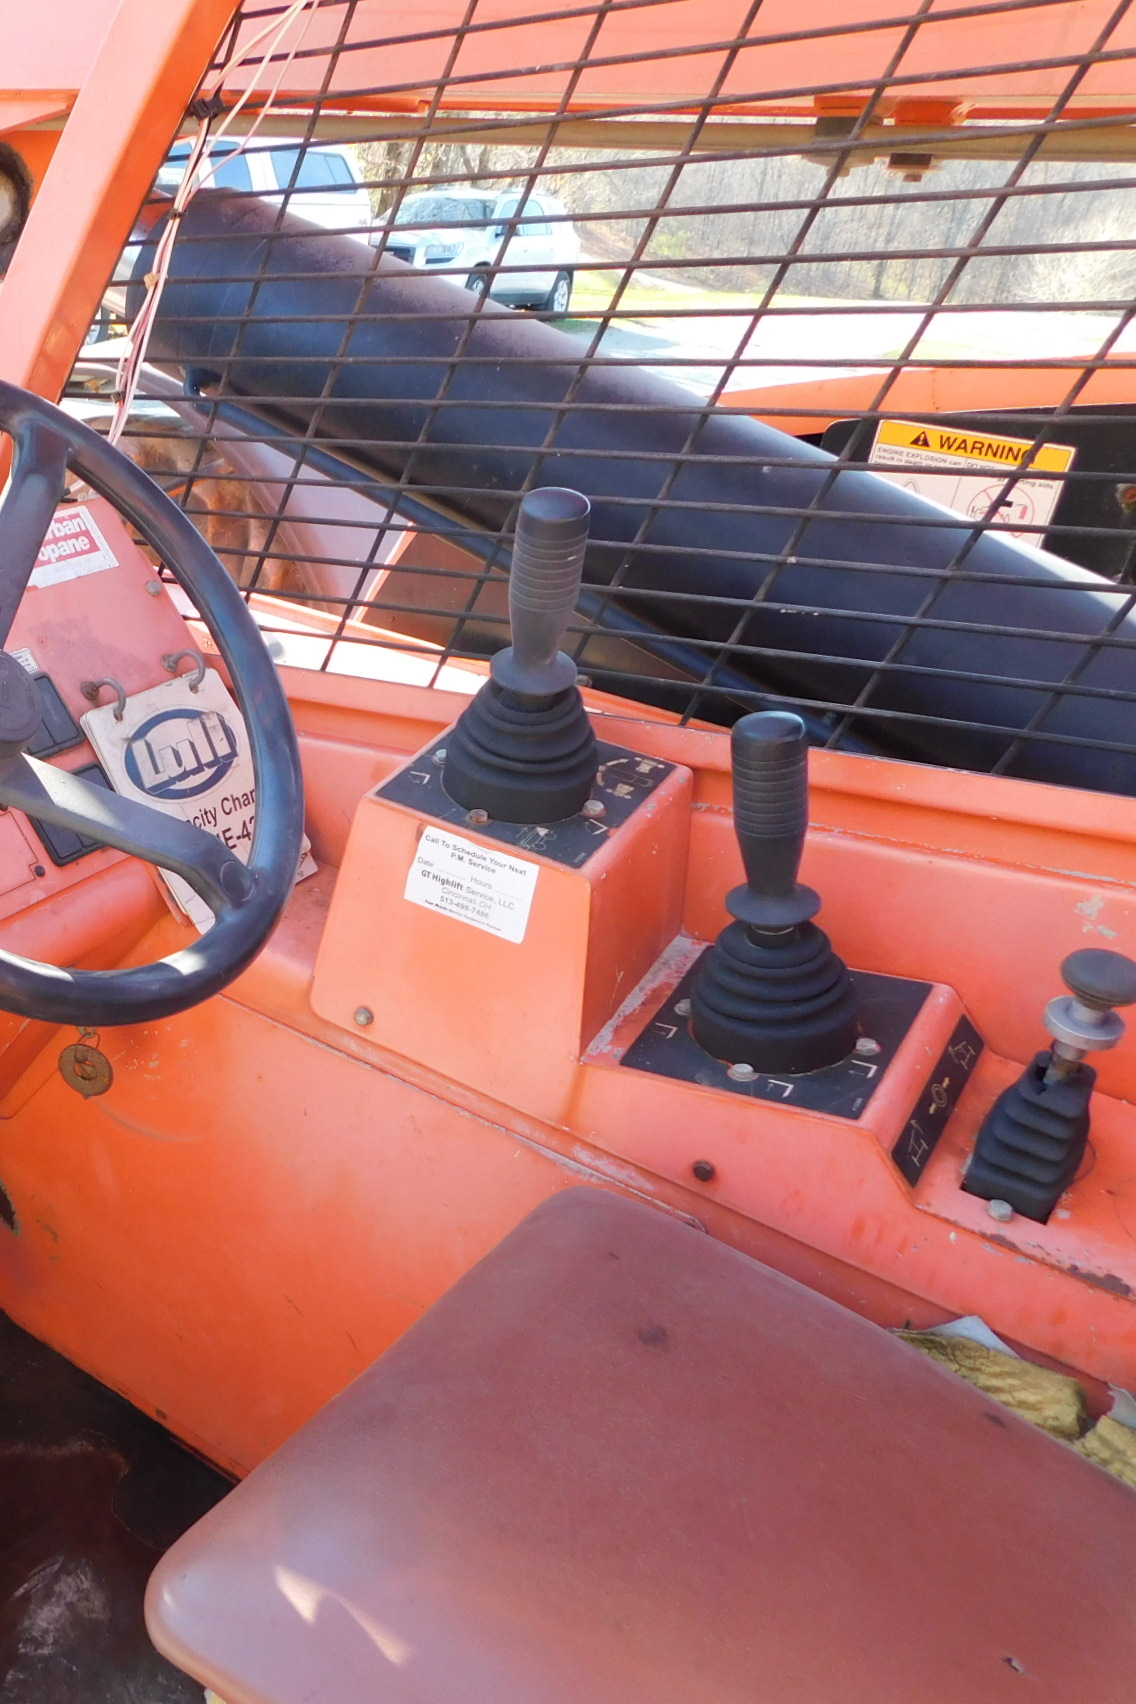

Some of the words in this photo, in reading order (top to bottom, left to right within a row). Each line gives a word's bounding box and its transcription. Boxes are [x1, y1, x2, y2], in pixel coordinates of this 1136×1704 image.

[45, 516, 87, 539] rban
[38, 536, 91, 562] opane
[132, 711, 239, 794] Lull
[185, 806, 218, 828] city
[220, 789, 255, 816] Char
[425, 834, 440, 844] Call
[442, 840, 450, 848] To
[452, 844, 487, 862] Schedule
[489, 857, 506, 869] Your
[508, 865, 526, 876] Next
[468, 858, 496, 874] Service
[417, 856, 434, 868] Date
[470, 876, 492, 890] Hours
[421, 870, 431, 878] GT
[432, 873, 464, 892] Highlift
[442, 888, 476, 905] Cincinnati
[479, 901, 492, 910] OH
